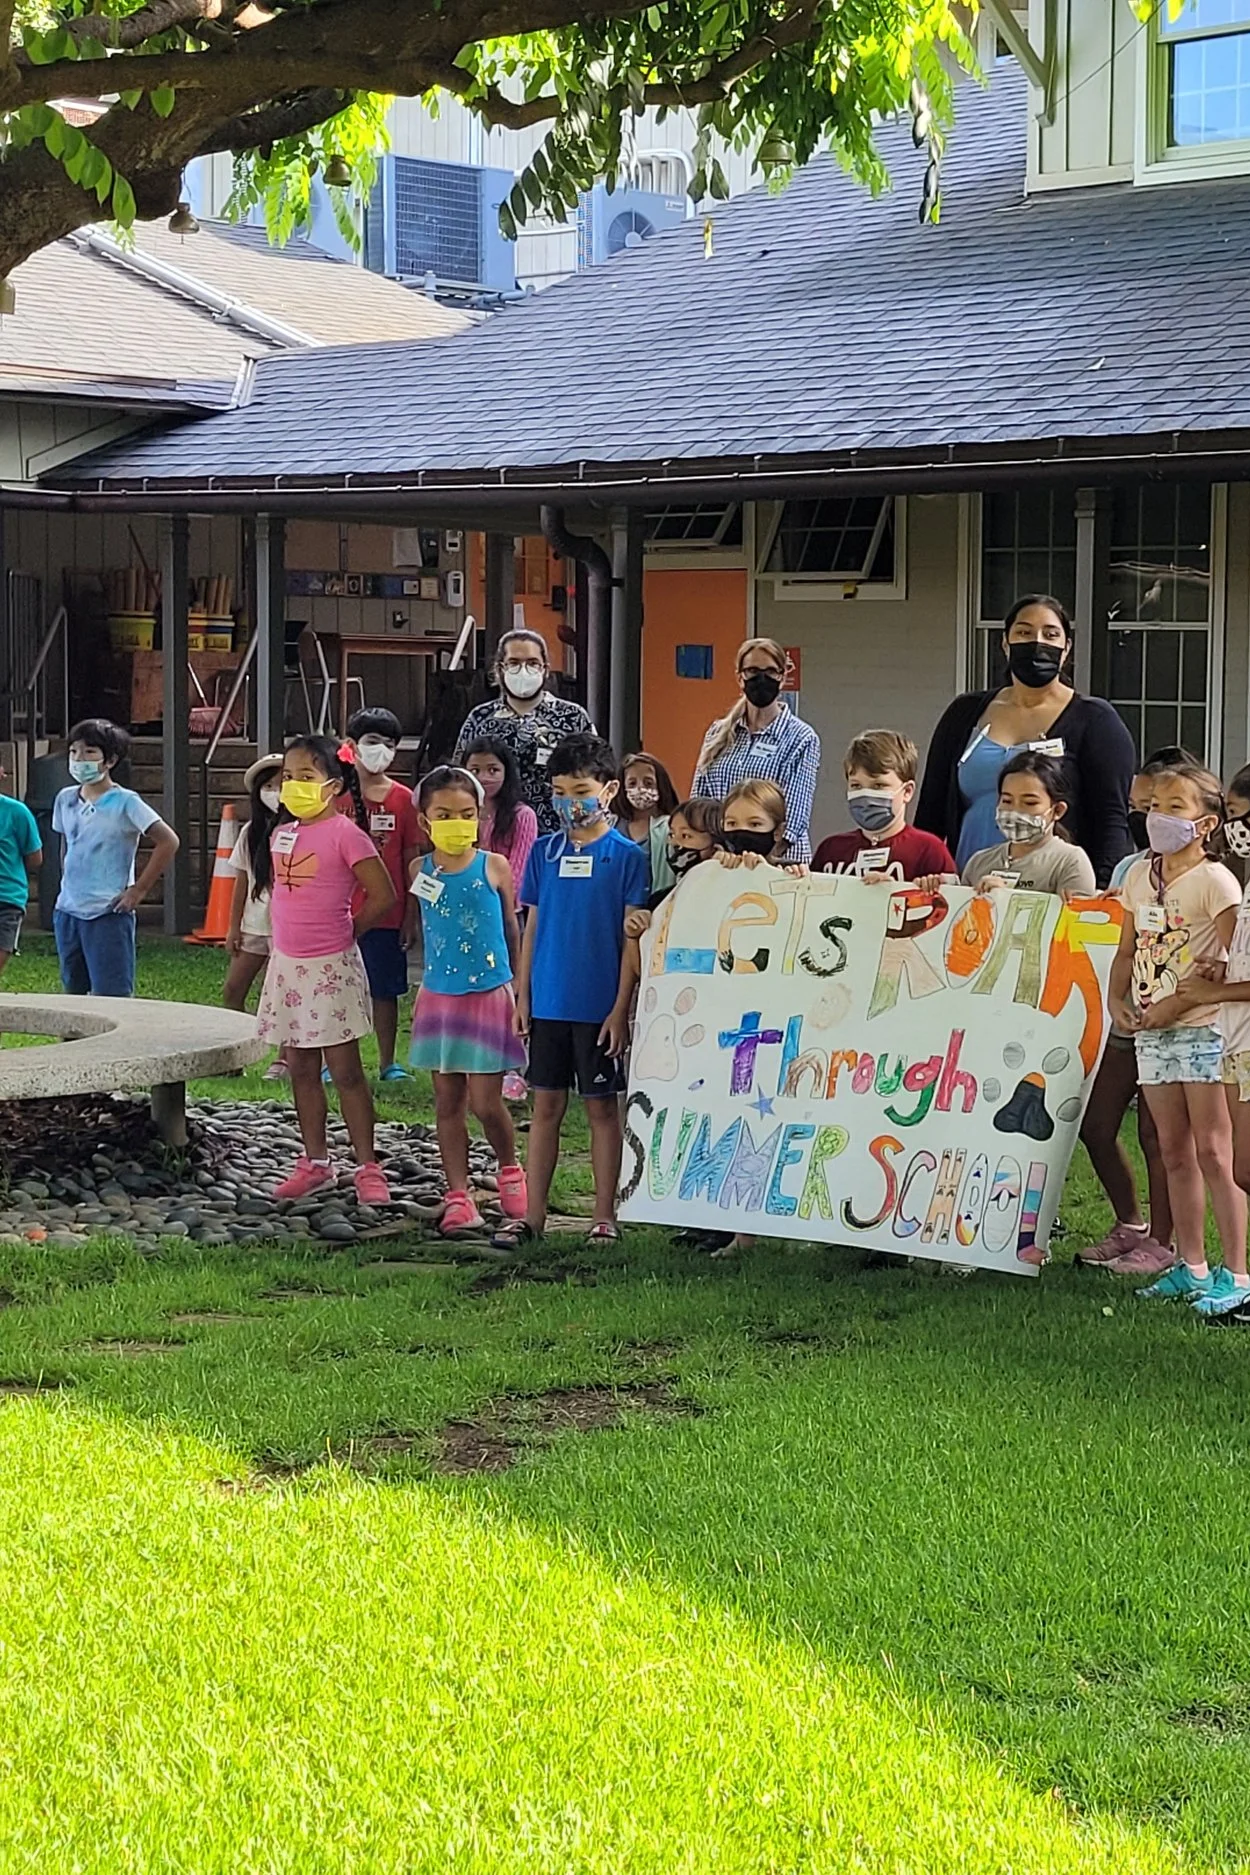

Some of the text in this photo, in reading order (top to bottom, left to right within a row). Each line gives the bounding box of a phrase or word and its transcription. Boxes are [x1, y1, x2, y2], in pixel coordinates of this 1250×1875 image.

[717, 1010, 978, 1127] through
[866, 888, 1124, 1080] ROAR
[617, 1090, 1049, 1266] SUMMER SCHOOL
